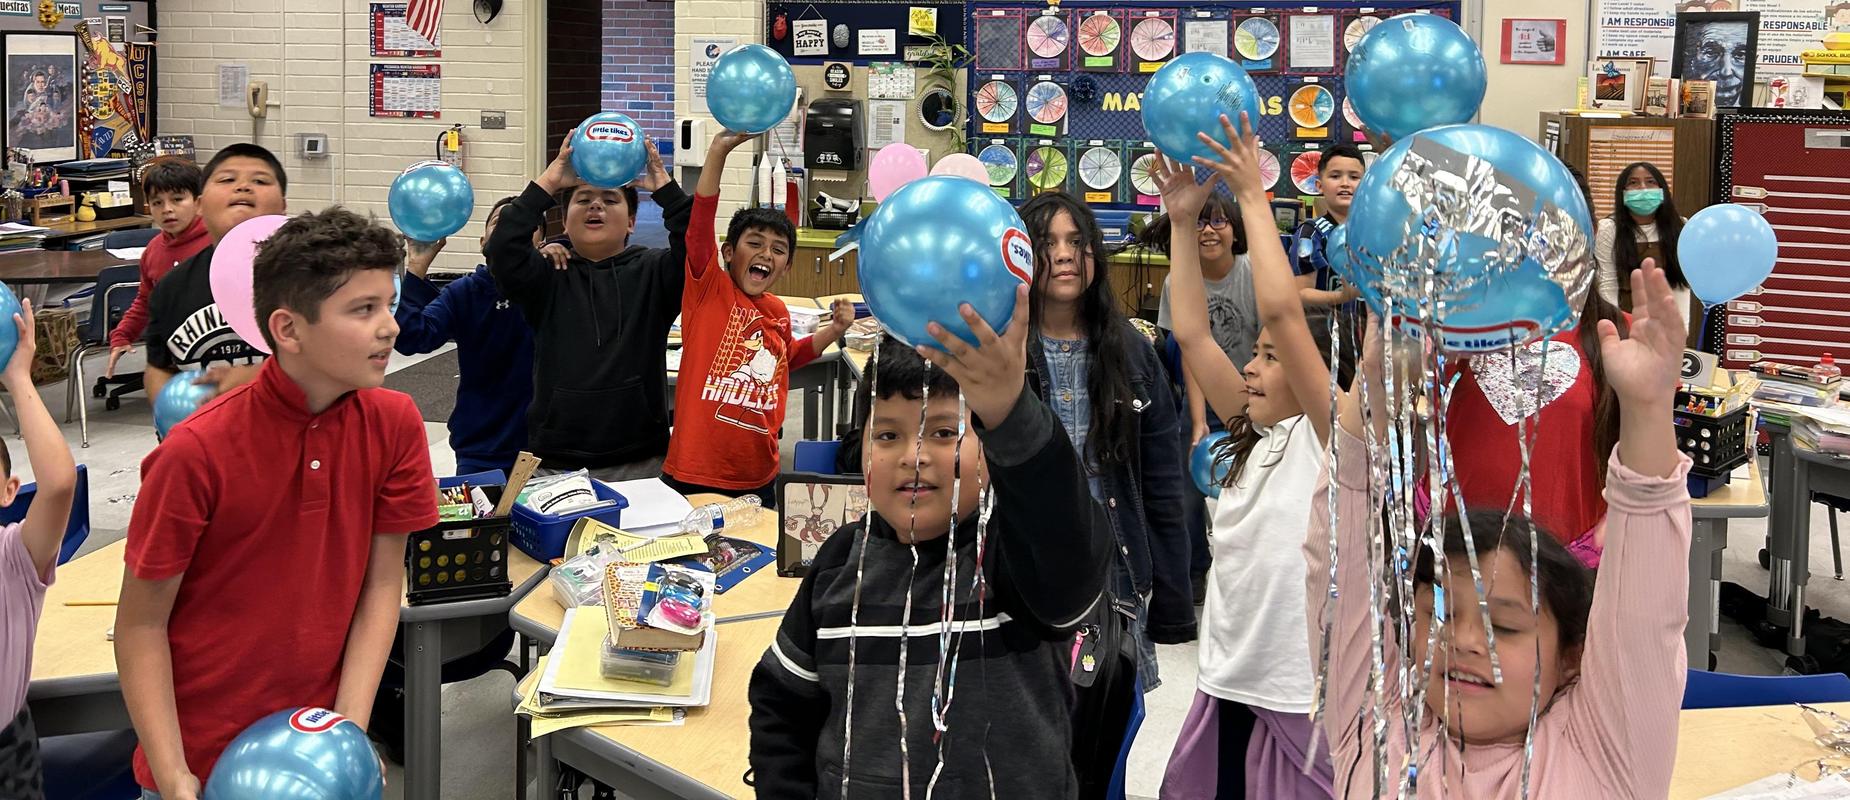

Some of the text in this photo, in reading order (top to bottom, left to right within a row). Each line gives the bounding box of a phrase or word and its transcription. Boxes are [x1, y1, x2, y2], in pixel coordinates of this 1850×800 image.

[0, 1, 79, 15] uestras Metas
[1607, 18, 1621, 26] AM
[1624, 18, 1676, 27] RESPONSIB
[1763, 20, 1828, 31] RESPONSABLE
[796, 39, 824, 48] HAPPY
[132, 46, 145, 113] UCSB
[610, 128, 628, 136] tikes
[1681, 358, 1692, 372] 2
[458, 508, 469, 516] 12
